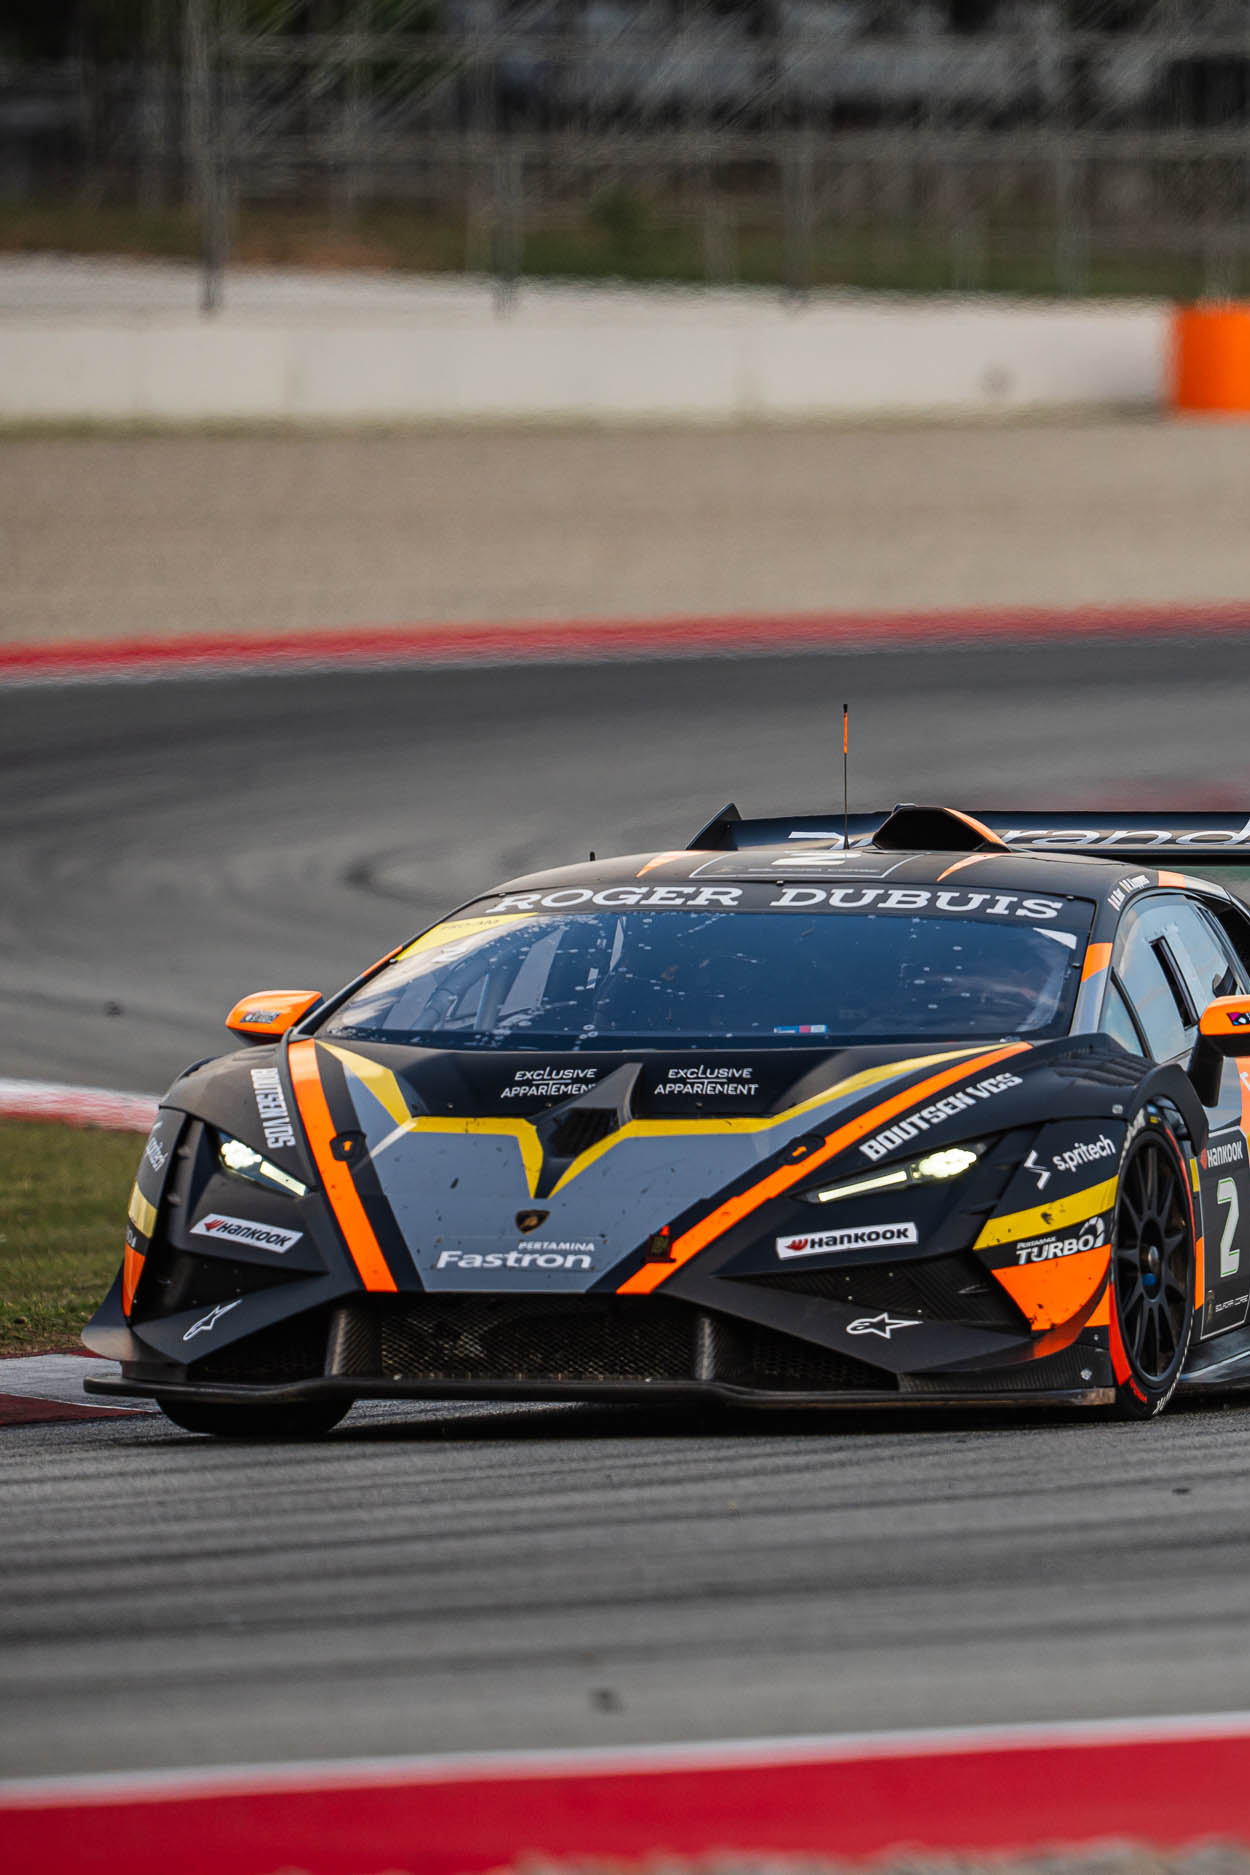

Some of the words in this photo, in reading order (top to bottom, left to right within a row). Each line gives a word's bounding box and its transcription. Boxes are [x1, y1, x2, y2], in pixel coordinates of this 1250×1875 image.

[485, 886, 744, 914] ROGER
[769, 888, 1063, 920] DUBUIS
[514, 1066, 597, 1081] EXCLUSIVE
[668, 1065, 752, 1080] EXCLUSIVE
[500, 1081, 597, 1098] APPARTEMEN
[654, 1080, 759, 1096] APPARTEMENT
[859, 1091, 977, 1162] BOUTSEN
[1052, 1134, 1116, 1172] s.pritech
[1217, 1176, 1241, 1278] 2
[518, 1240, 595, 1252] PERTAMINA
[1016, 1234, 1094, 1265] TURBO
[436, 1250, 592, 1269] Fastron
